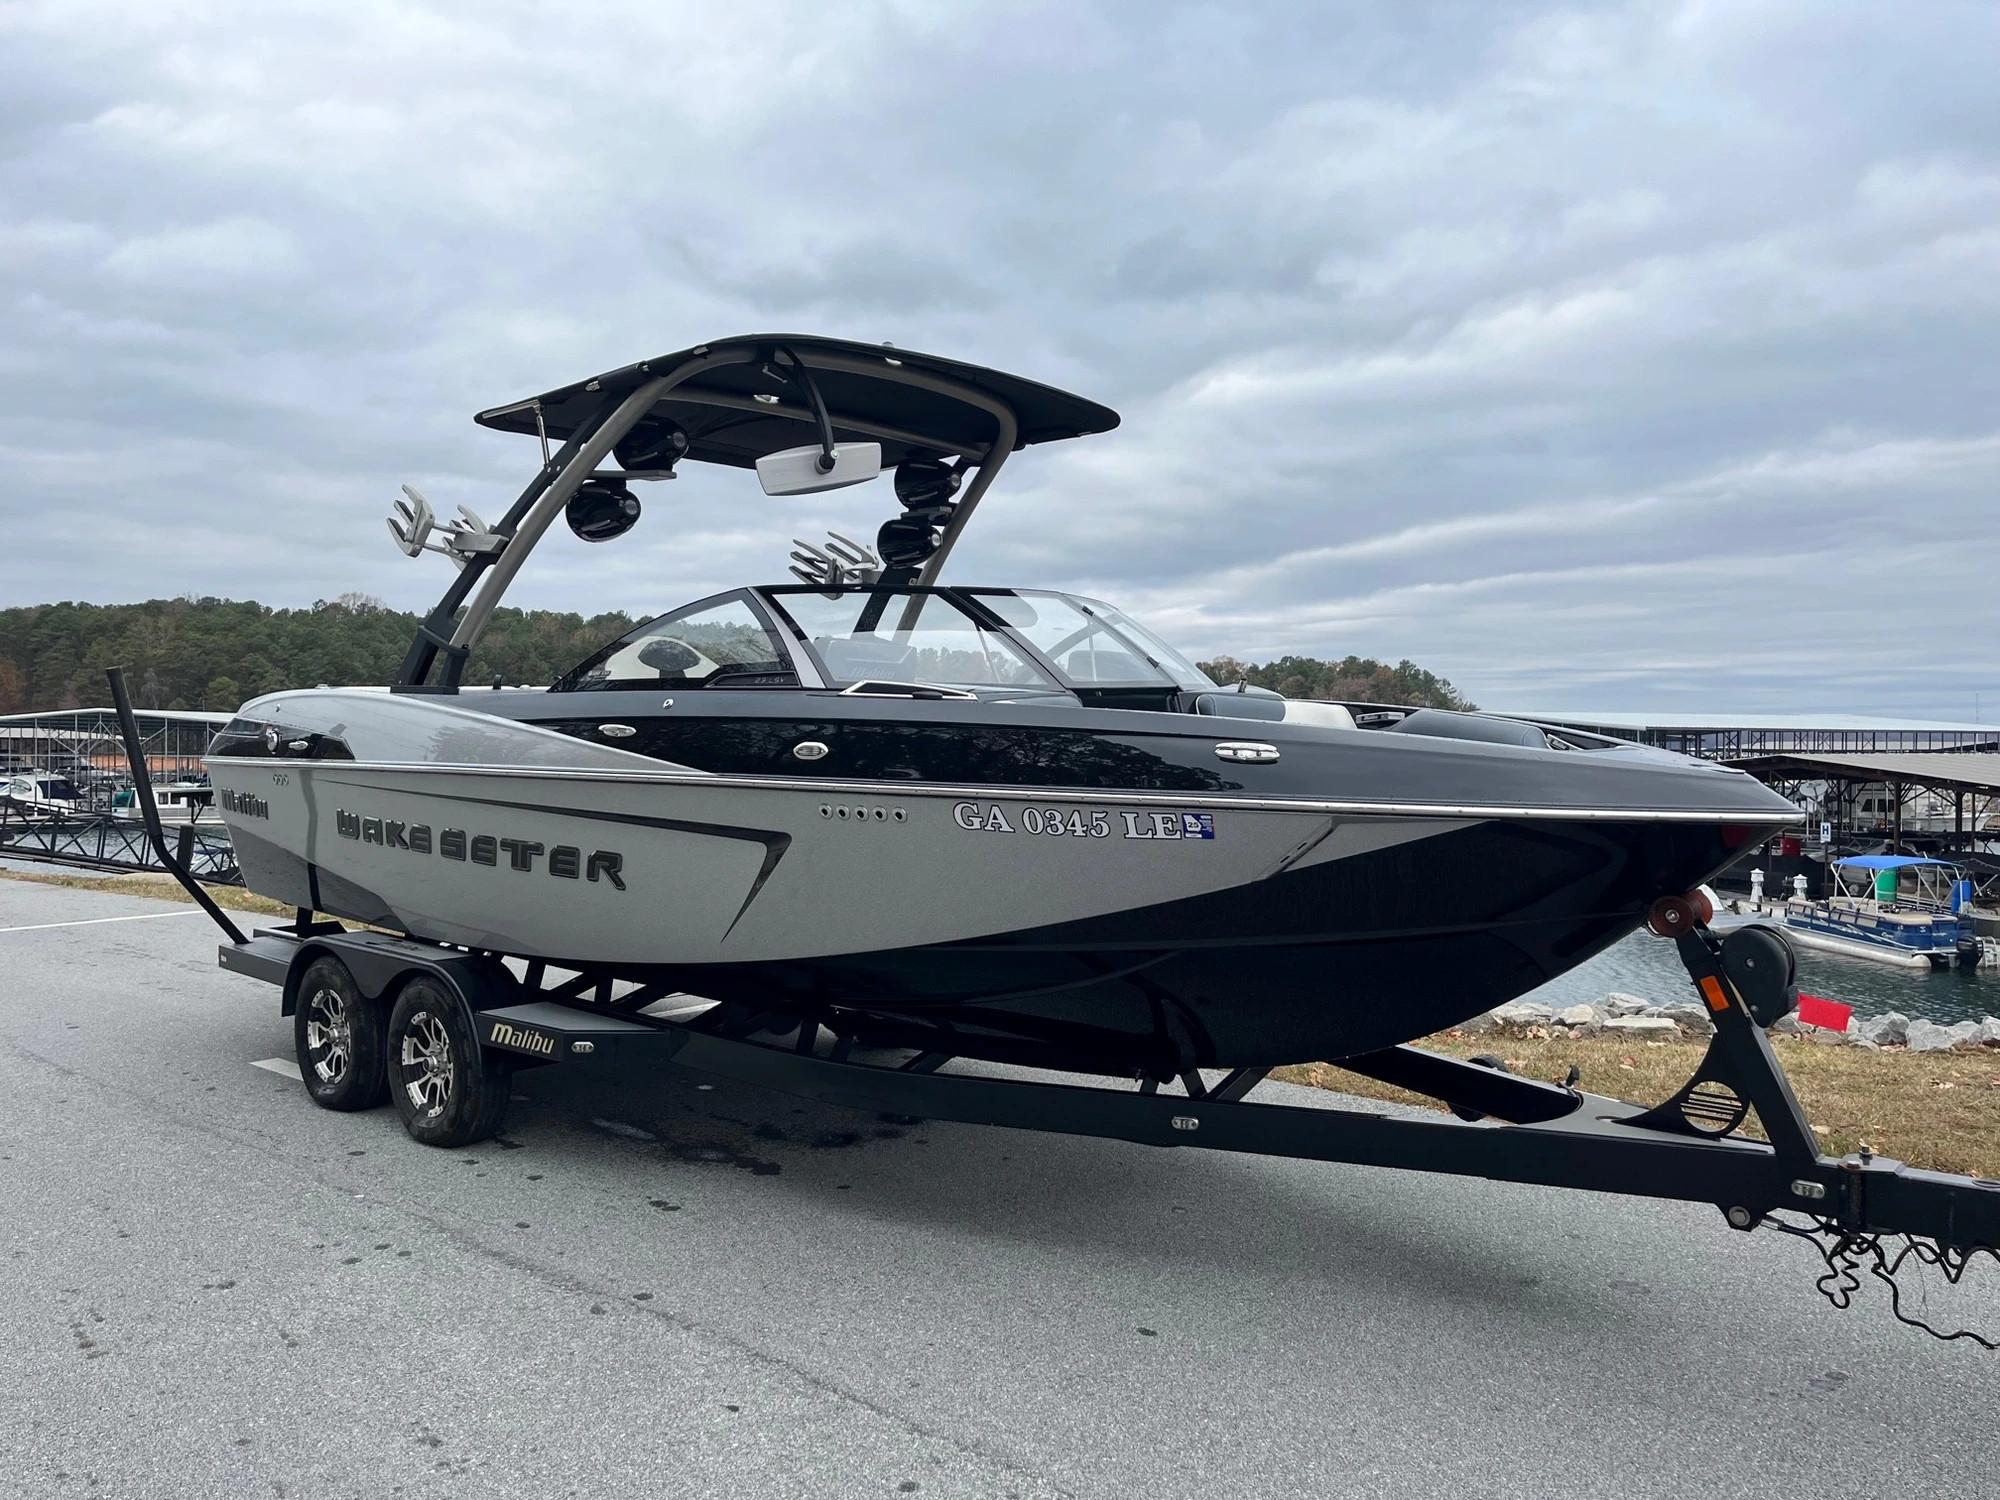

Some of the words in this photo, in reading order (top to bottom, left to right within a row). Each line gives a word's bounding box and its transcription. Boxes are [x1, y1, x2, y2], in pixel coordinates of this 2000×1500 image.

[221, 787, 269, 820] Malibu
[952, 802, 1015, 833] GA
[1022, 807, 1111, 838] 0345
[1120, 811, 1182, 840] LE
[1822, 825, 1829, 835] H
[490, 1022, 555, 1054] Malibu
